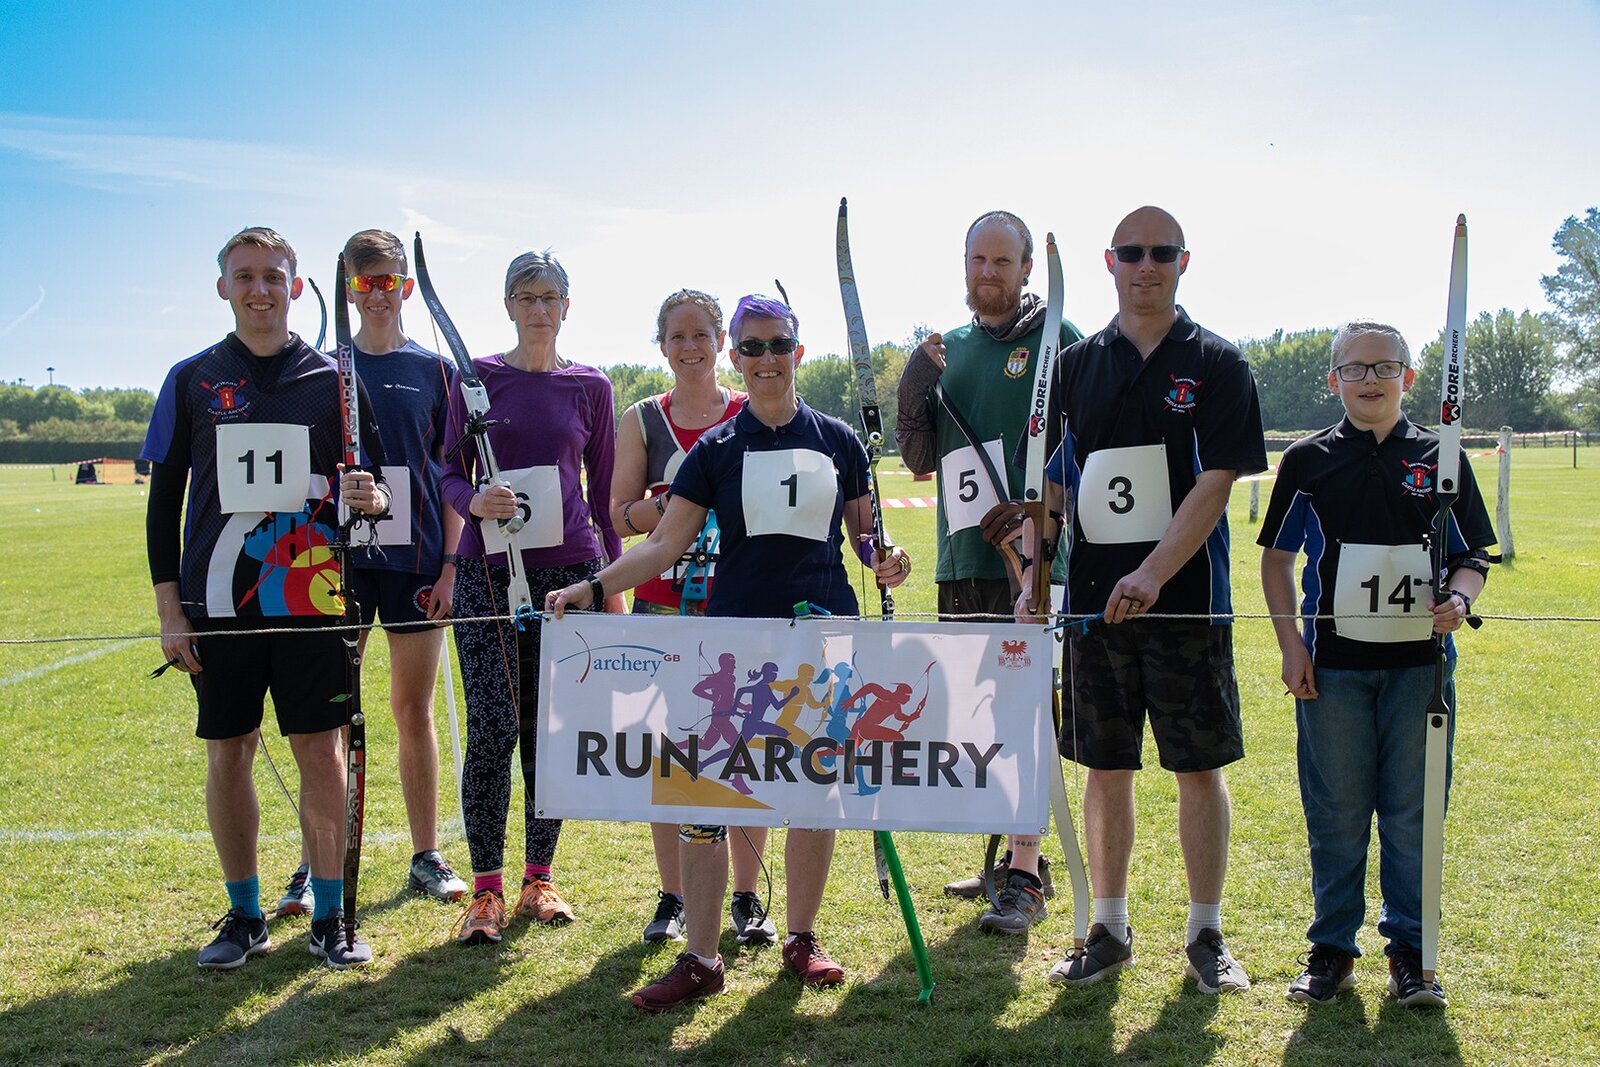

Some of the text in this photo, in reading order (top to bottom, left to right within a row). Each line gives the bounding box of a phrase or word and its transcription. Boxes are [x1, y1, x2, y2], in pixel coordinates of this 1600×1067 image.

[338, 341, 356, 415] ARCHERY
[1035, 345, 1051, 418] CORE ARCHERY
[1447, 329, 1459, 404] CORE ARCHERY
[238, 450, 282, 485] 11
[958, 469, 979, 503] 5
[780, 474, 797, 507] 1
[1108, 476, 1135, 514] 3
[1360, 574, 1416, 613] 14
[593, 653, 681, 678] archery GB
[576, 731, 1004, 788] RUN ARCHERY
